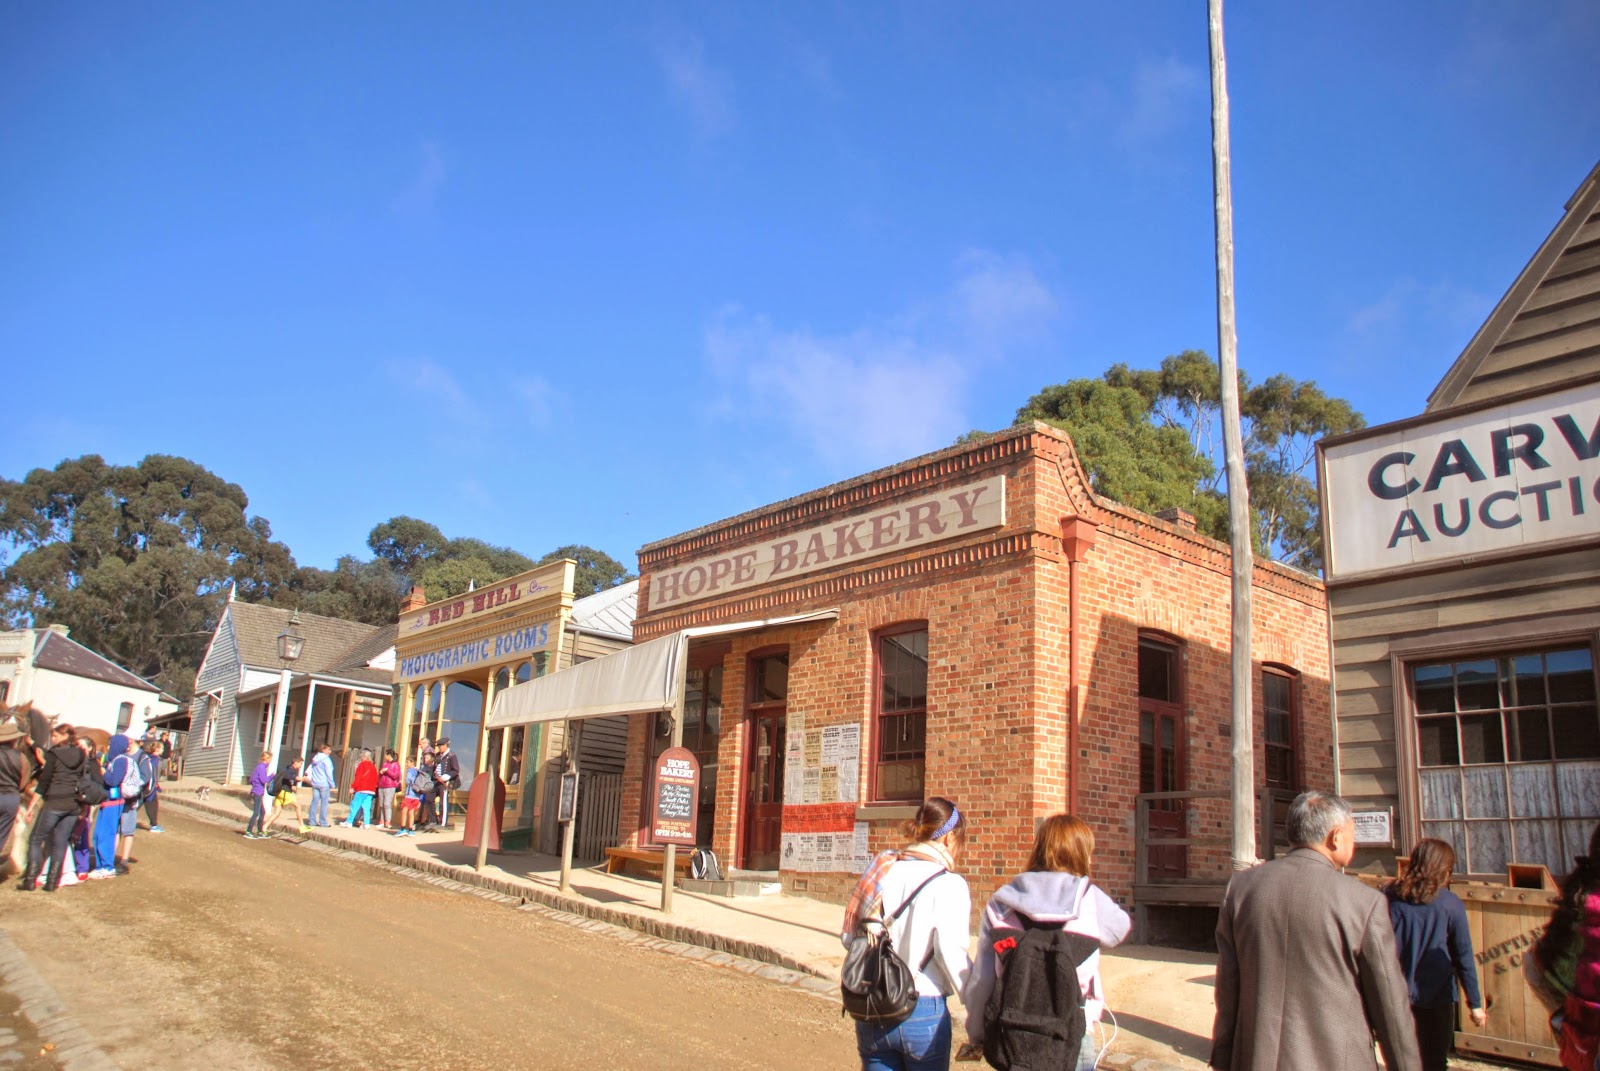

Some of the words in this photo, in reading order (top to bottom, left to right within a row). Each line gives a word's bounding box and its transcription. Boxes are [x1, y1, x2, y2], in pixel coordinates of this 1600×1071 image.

[1368, 413, 1600, 500] CARV
[1387, 475, 1600, 549] AUCTI
[654, 550, 757, 605] HOPE
[769, 486, 988, 579] BAKERY
[428, 601, 465, 626] RED
[472, 583, 521, 613] HILL
[401, 639, 490, 677] PHOTOGRAPHIC
[494, 623, 549, 657] ROOMS
[660, 767, 695, 778] BAKERY
[667, 759, 690, 769] HOPE
[655, 829, 671, 837] OPEN
[1494, 961, 1508, 975] &
